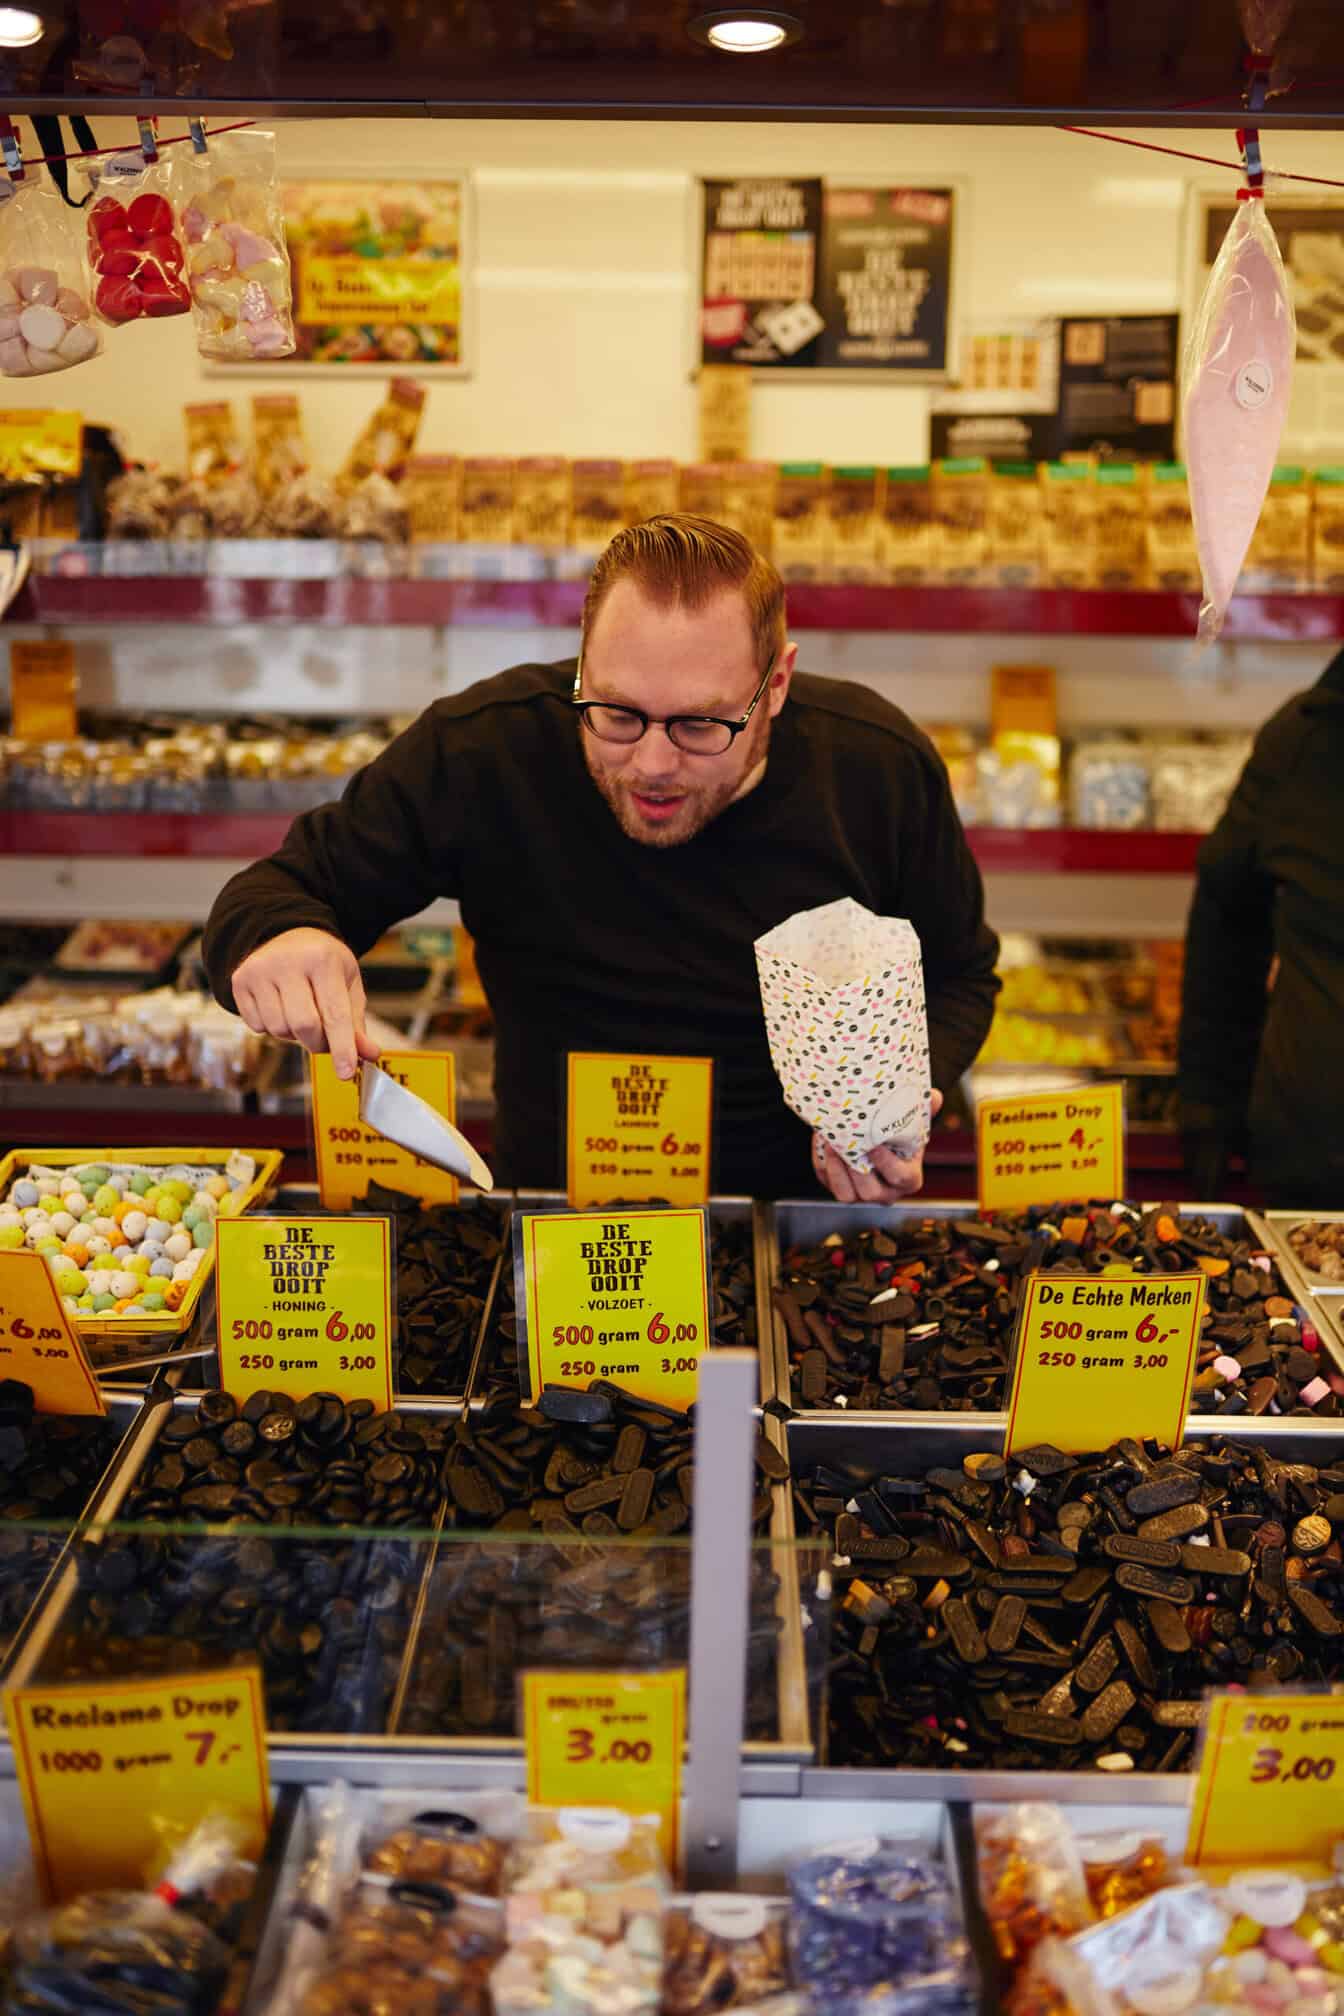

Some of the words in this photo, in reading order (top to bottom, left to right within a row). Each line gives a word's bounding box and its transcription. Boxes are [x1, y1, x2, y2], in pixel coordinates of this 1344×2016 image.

[612, 1077, 669, 1090] BESTE
[617, 1091, 664, 1104] DROP
[618, 1104, 660, 1116] OOIT
[990, 1110, 1057, 1125] Reclame
[1066, 1104, 1103, 1120] Drop
[328, 1127, 361, 1143] 500
[585, 1137, 618, 1153] 500
[622, 1144, 655, 1154] gram
[993, 1140, 1025, 1157] 500
[1029, 1143, 1062, 1153] gram
[336, 1152, 362, 1165] 250
[367, 1156, 398, 1166] gram
[622, 1168, 653, 1176] gram
[1029, 1163, 1062, 1174] gram
[285, 1227, 314, 1244] DE
[602, 1223, 631, 1241] DE
[263, 1244, 336, 1261] BESTE
[580, 1240, 654, 1259] BESTE
[270, 1261, 331, 1278] DROP
[588, 1258, 648, 1275] DROP
[273, 1278, 327, 1295] OOIT
[591, 1274, 645, 1293] OOIT
[1039, 1285, 1065, 1305] De
[1072, 1286, 1124, 1307] Echte
[1130, 1285, 1193, 1307] Merken
[272, 1300, 328, 1313] HONING
[587, 1298, 646, 1312] VOLZOET
[231, 1320, 273, 1341] 500
[277, 1325, 320, 1342] gram
[325, 1310, 377, 1343] 6,00
[552, 1325, 594, 1347] 500
[598, 1330, 641, 1346] gram
[647, 1312, 698, 1345] 6,00
[1039, 1320, 1083, 1340] 500
[1086, 1328, 1129, 1342] gram
[1135, 1313, 1180, 1344] 6,-
[239, 1355, 275, 1370] 250
[279, 1359, 319, 1372] gram
[339, 1356, 377, 1372] 3,00
[560, 1361, 596, 1377] 250
[600, 1364, 641, 1377] gram
[661, 1358, 698, 1374] 3,00
[1038, 1351, 1077, 1367] 250
[1081, 1356, 1125, 1369] gram
[1133, 1354, 1169, 1369] 3,00
[31, 1705, 163, 1729] Reclame
[172, 1696, 240, 1719] Drop
[40, 1751, 103, 1773] 1000
[114, 1752, 172, 1772] gram
[1250, 1747, 1336, 1784] 3,00
